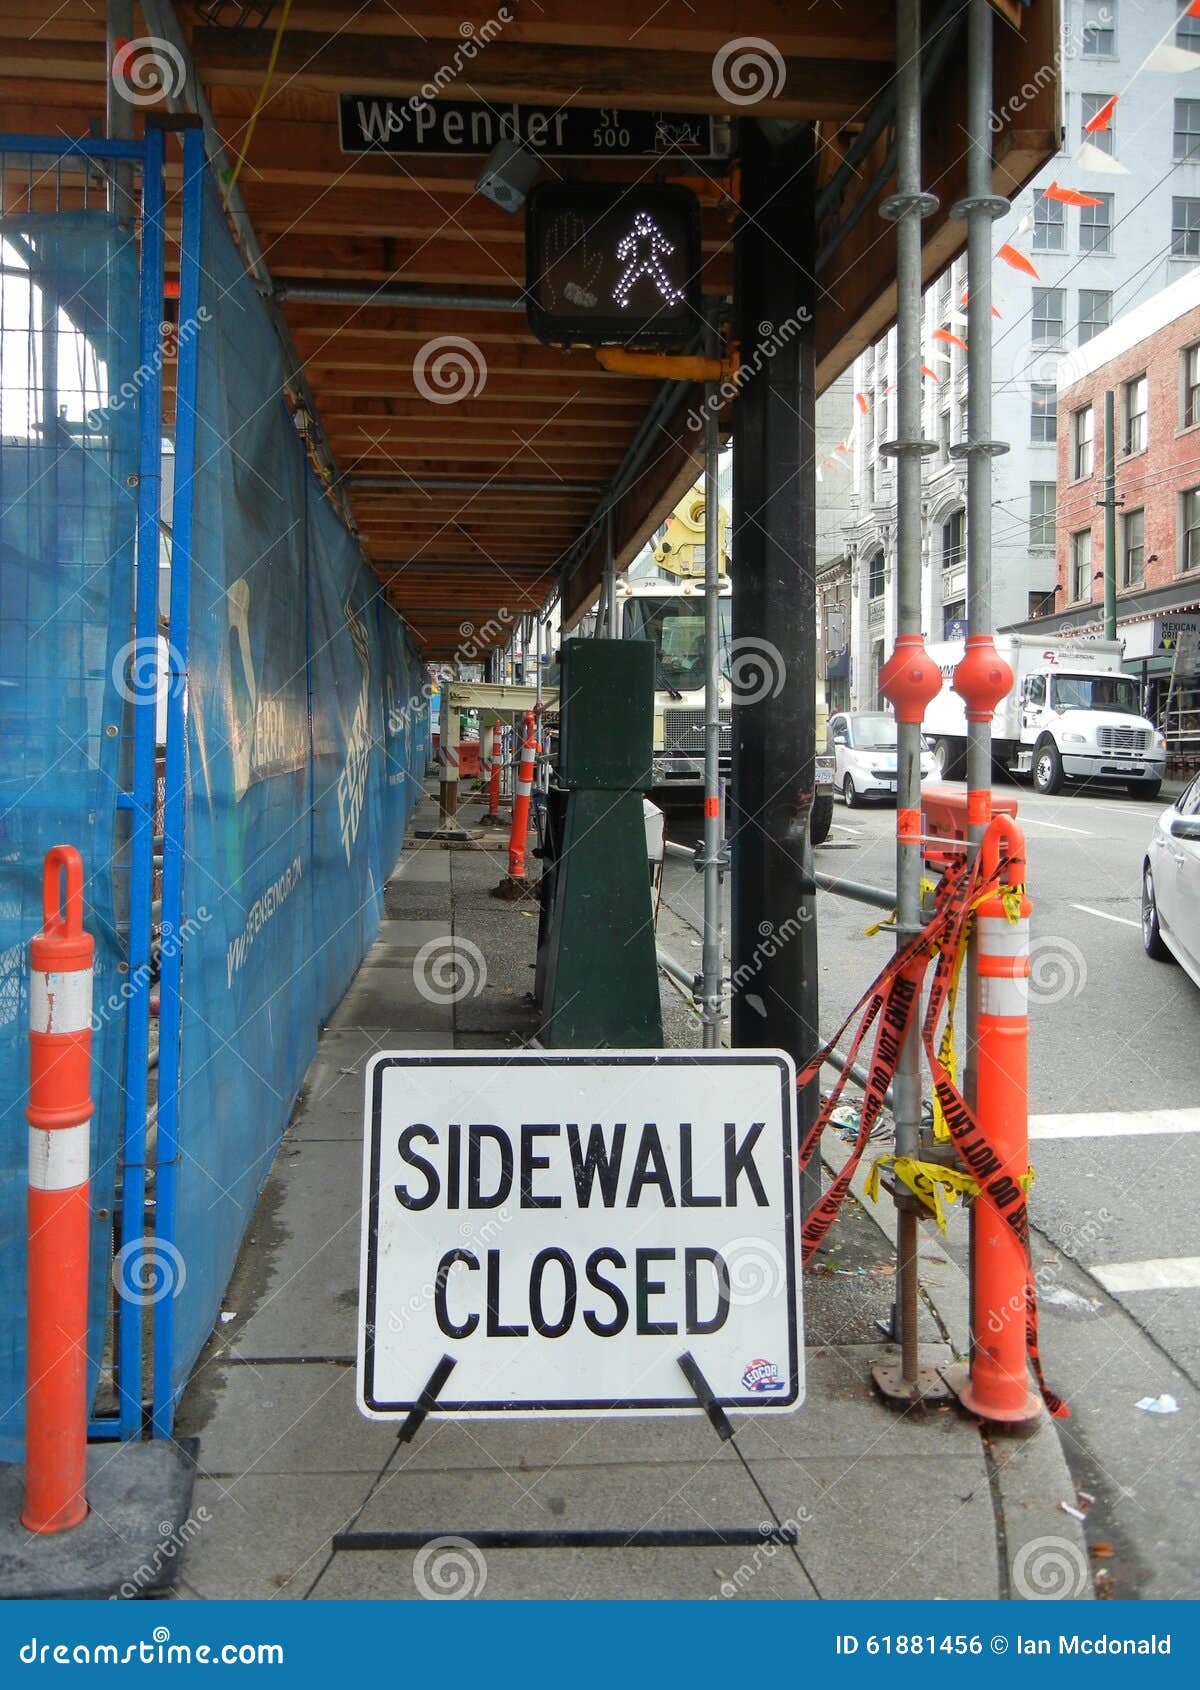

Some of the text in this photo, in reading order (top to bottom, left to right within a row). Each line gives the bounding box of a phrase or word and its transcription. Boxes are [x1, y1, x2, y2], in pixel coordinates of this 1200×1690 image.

[357, 102, 569, 147] W Pender
[593, 129, 630, 147] 500
[601, 108, 620, 127] St
[1162, 622, 1196, 632] MEXICAN
[884, 975, 917, 1033] ENTER
[877, 1027, 899, 1069] NOT
[394, 1123, 770, 1212] SIDEWALK
[960, 1137, 1002, 1180] NOT
[987, 1175, 1021, 1209] DO
[433, 1246, 731, 1339] CLOSED
[742, 1364, 777, 1389] LEDCOR
